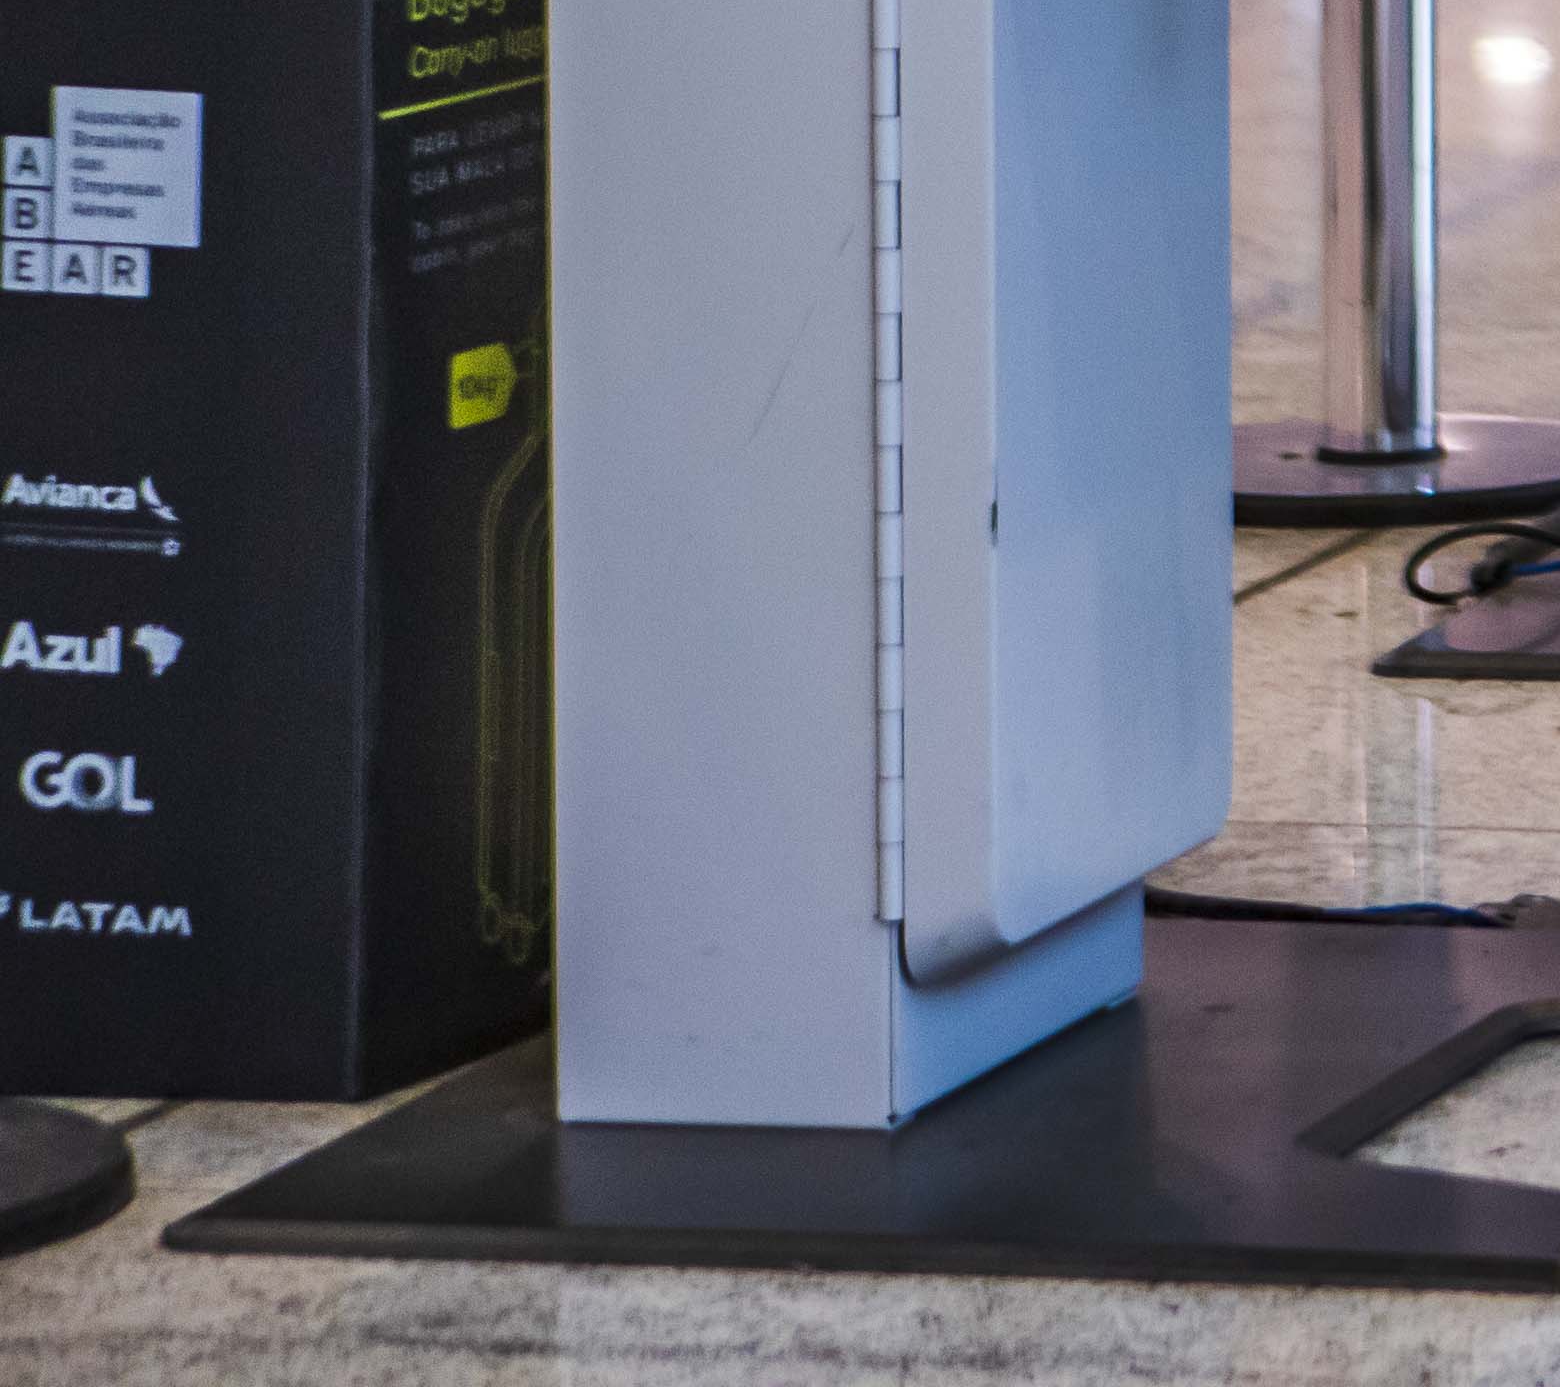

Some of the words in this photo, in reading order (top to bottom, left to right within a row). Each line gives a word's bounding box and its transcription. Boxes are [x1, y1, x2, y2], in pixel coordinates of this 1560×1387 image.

[16, 145, 40, 177] A
[15, 196, 39, 230] B
[2, 473, 138, 512] Avianca
[1, 620, 123, 675] Azul
[20, 750, 155, 814] GOL
[19, 898, 193, 937] LATAM
